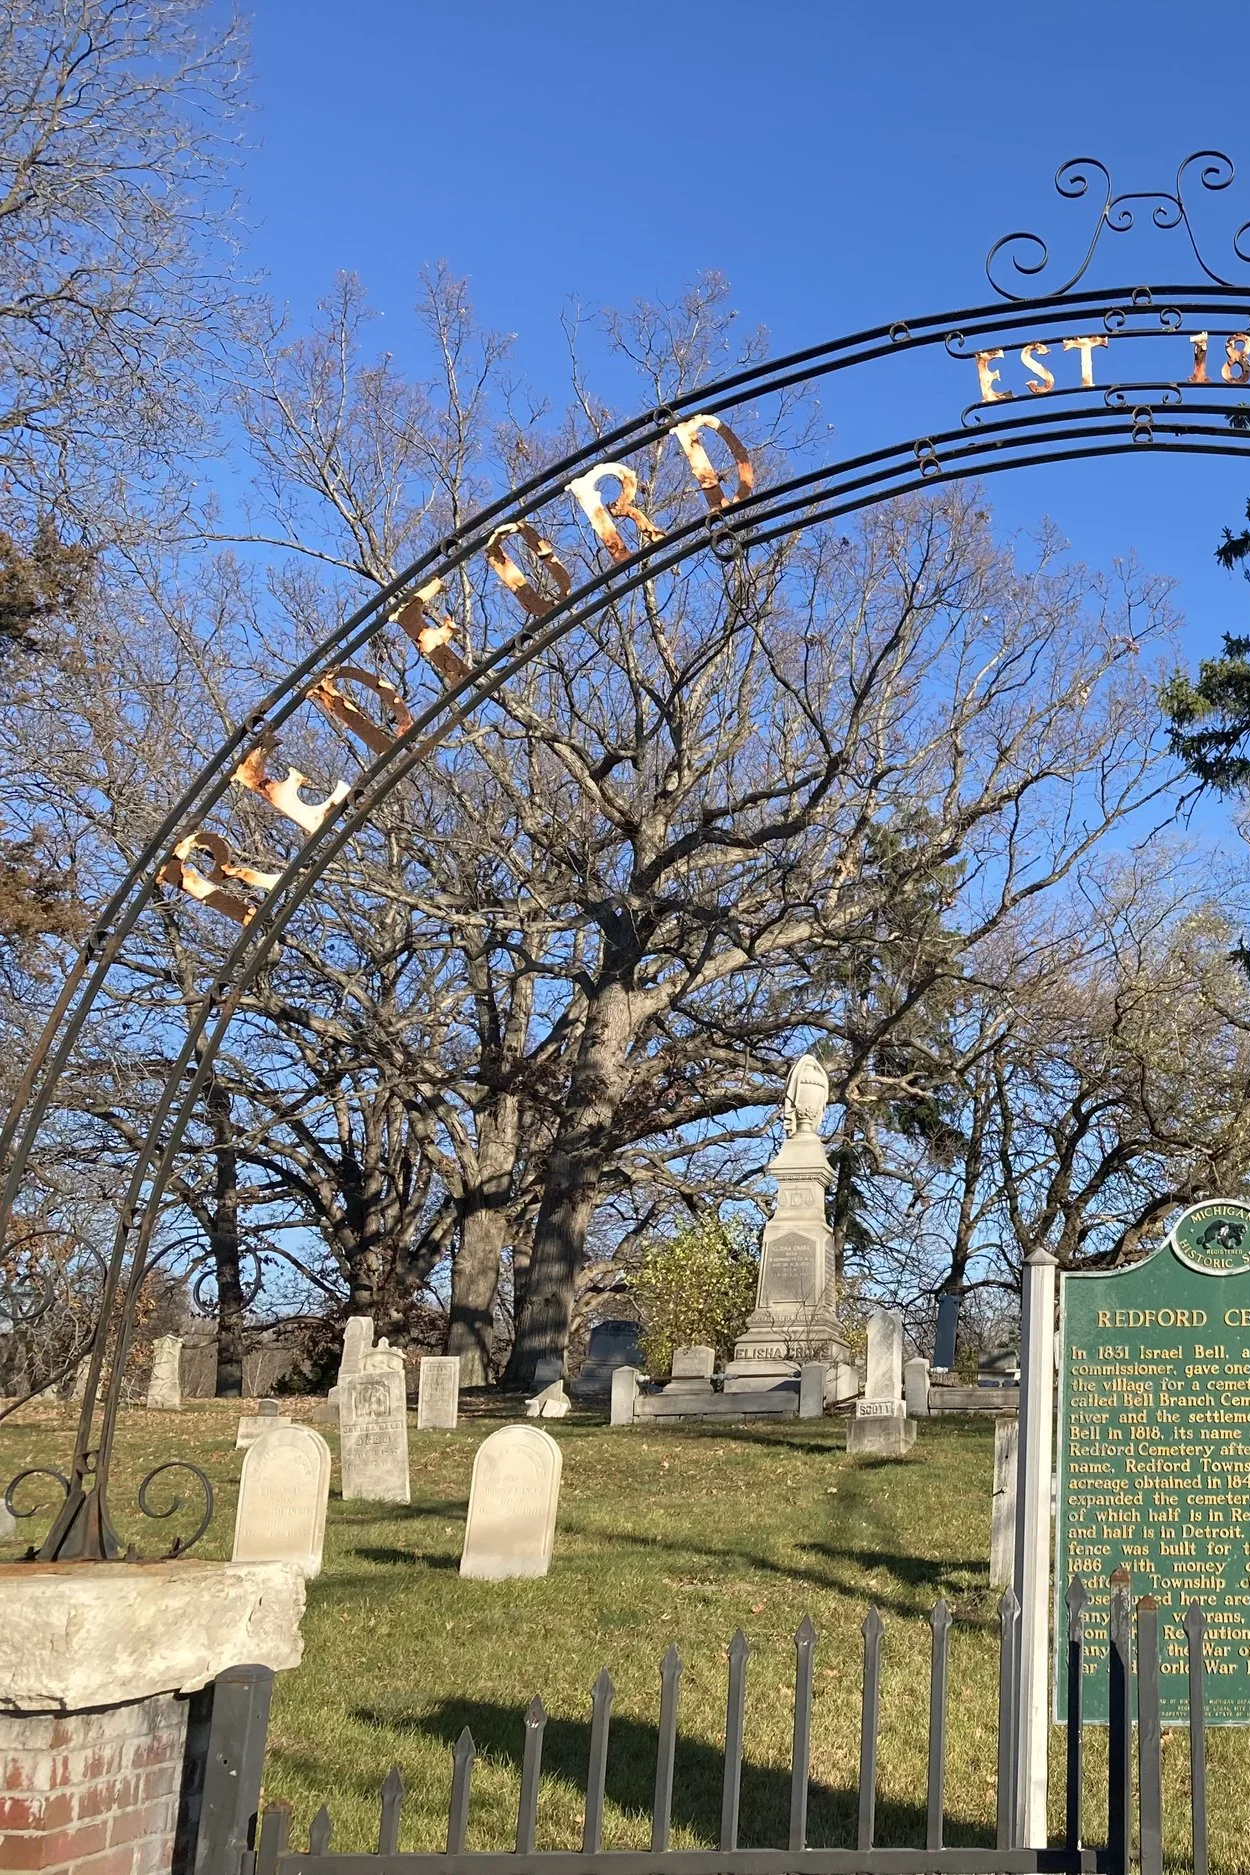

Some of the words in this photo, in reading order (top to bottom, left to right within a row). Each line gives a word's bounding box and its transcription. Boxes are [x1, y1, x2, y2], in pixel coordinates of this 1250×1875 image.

[974, 336, 1109, 402] EST
[156, 413, 755, 927] REDFORD
[1179, 1238, 1234, 1268] HISTORIC
[1097, 1308, 1207, 1327] REDFORD
[735, 1347, 783, 1359] ELISHA
[1071, 1347, 1087, 1359] In
[1098, 1347, 1129, 1359] 1831
[1139, 1347, 1183, 1359] Israel
[1242, 1351, 1250, 1359] a
[1185, 1365, 1220, 1379] gave
[1224, 1365, 1250, 1375] one
[1071, 1377, 1096, 1391] the
[1102, 1377, 1153, 1395] village
[1160, 1377, 1185, 1391] for
[1192, 1381, 1200, 1391] a
[1070, 1392, 1117, 1406] called
[1122, 1392, 1153, 1406] Bell
[1159, 1392, 1215, 1406] Branch
[1070, 1409, 1109, 1422] river
[1119, 1409, 1147, 1422] and
[1156, 1409, 1182, 1422] the
[1070, 1426, 1100, 1439] Bell
[1108, 1426, 1123, 1439] in
[1173, 1426, 1193, 1439] its
[1200, 1430, 1242, 1439] name
[1069, 1442, 1134, 1456] Redford
[1138, 1442, 1214, 1460] Cemetery
[1126, 1458, 1191, 1472] Redford
[1068, 1479, 1129, 1492] acreage
[1135, 1475, 1202, 1488] obtained
[1207, 1475, 1222, 1488] in
[1068, 1491, 1144, 1508] expanded
[1153, 1491, 1179, 1504] the
[1068, 1507, 1087, 1521] of
[1095, 1507, 1141, 1521] which
[1149, 1507, 1182, 1521] half
[1189, 1507, 1203, 1521] is
[1209, 1507, 1224, 1521] in
[1068, 1524, 1097, 1538] and
[1102, 1524, 1136, 1538] half
[1143, 1524, 1155, 1538] is
[1161, 1524, 1175, 1538] in
[1068, 1541, 1111, 1555] fence
[1120, 1545, 1149, 1555] was
[1161, 1541, 1197, 1555] built
[1207, 1541, 1232, 1555] for
[1068, 1558, 1102, 1572] 1886
[1120, 1558, 1156, 1572] with
[1173, 1562, 1226, 1576] money
[1149, 1575, 1226, 1593] Township
[1180, 1591, 1217, 1605] here
[1172, 1612, 1246, 1624] verans,
[1202, 1642, 1234, 1656] War
[1205, 1659, 1238, 1673] War
